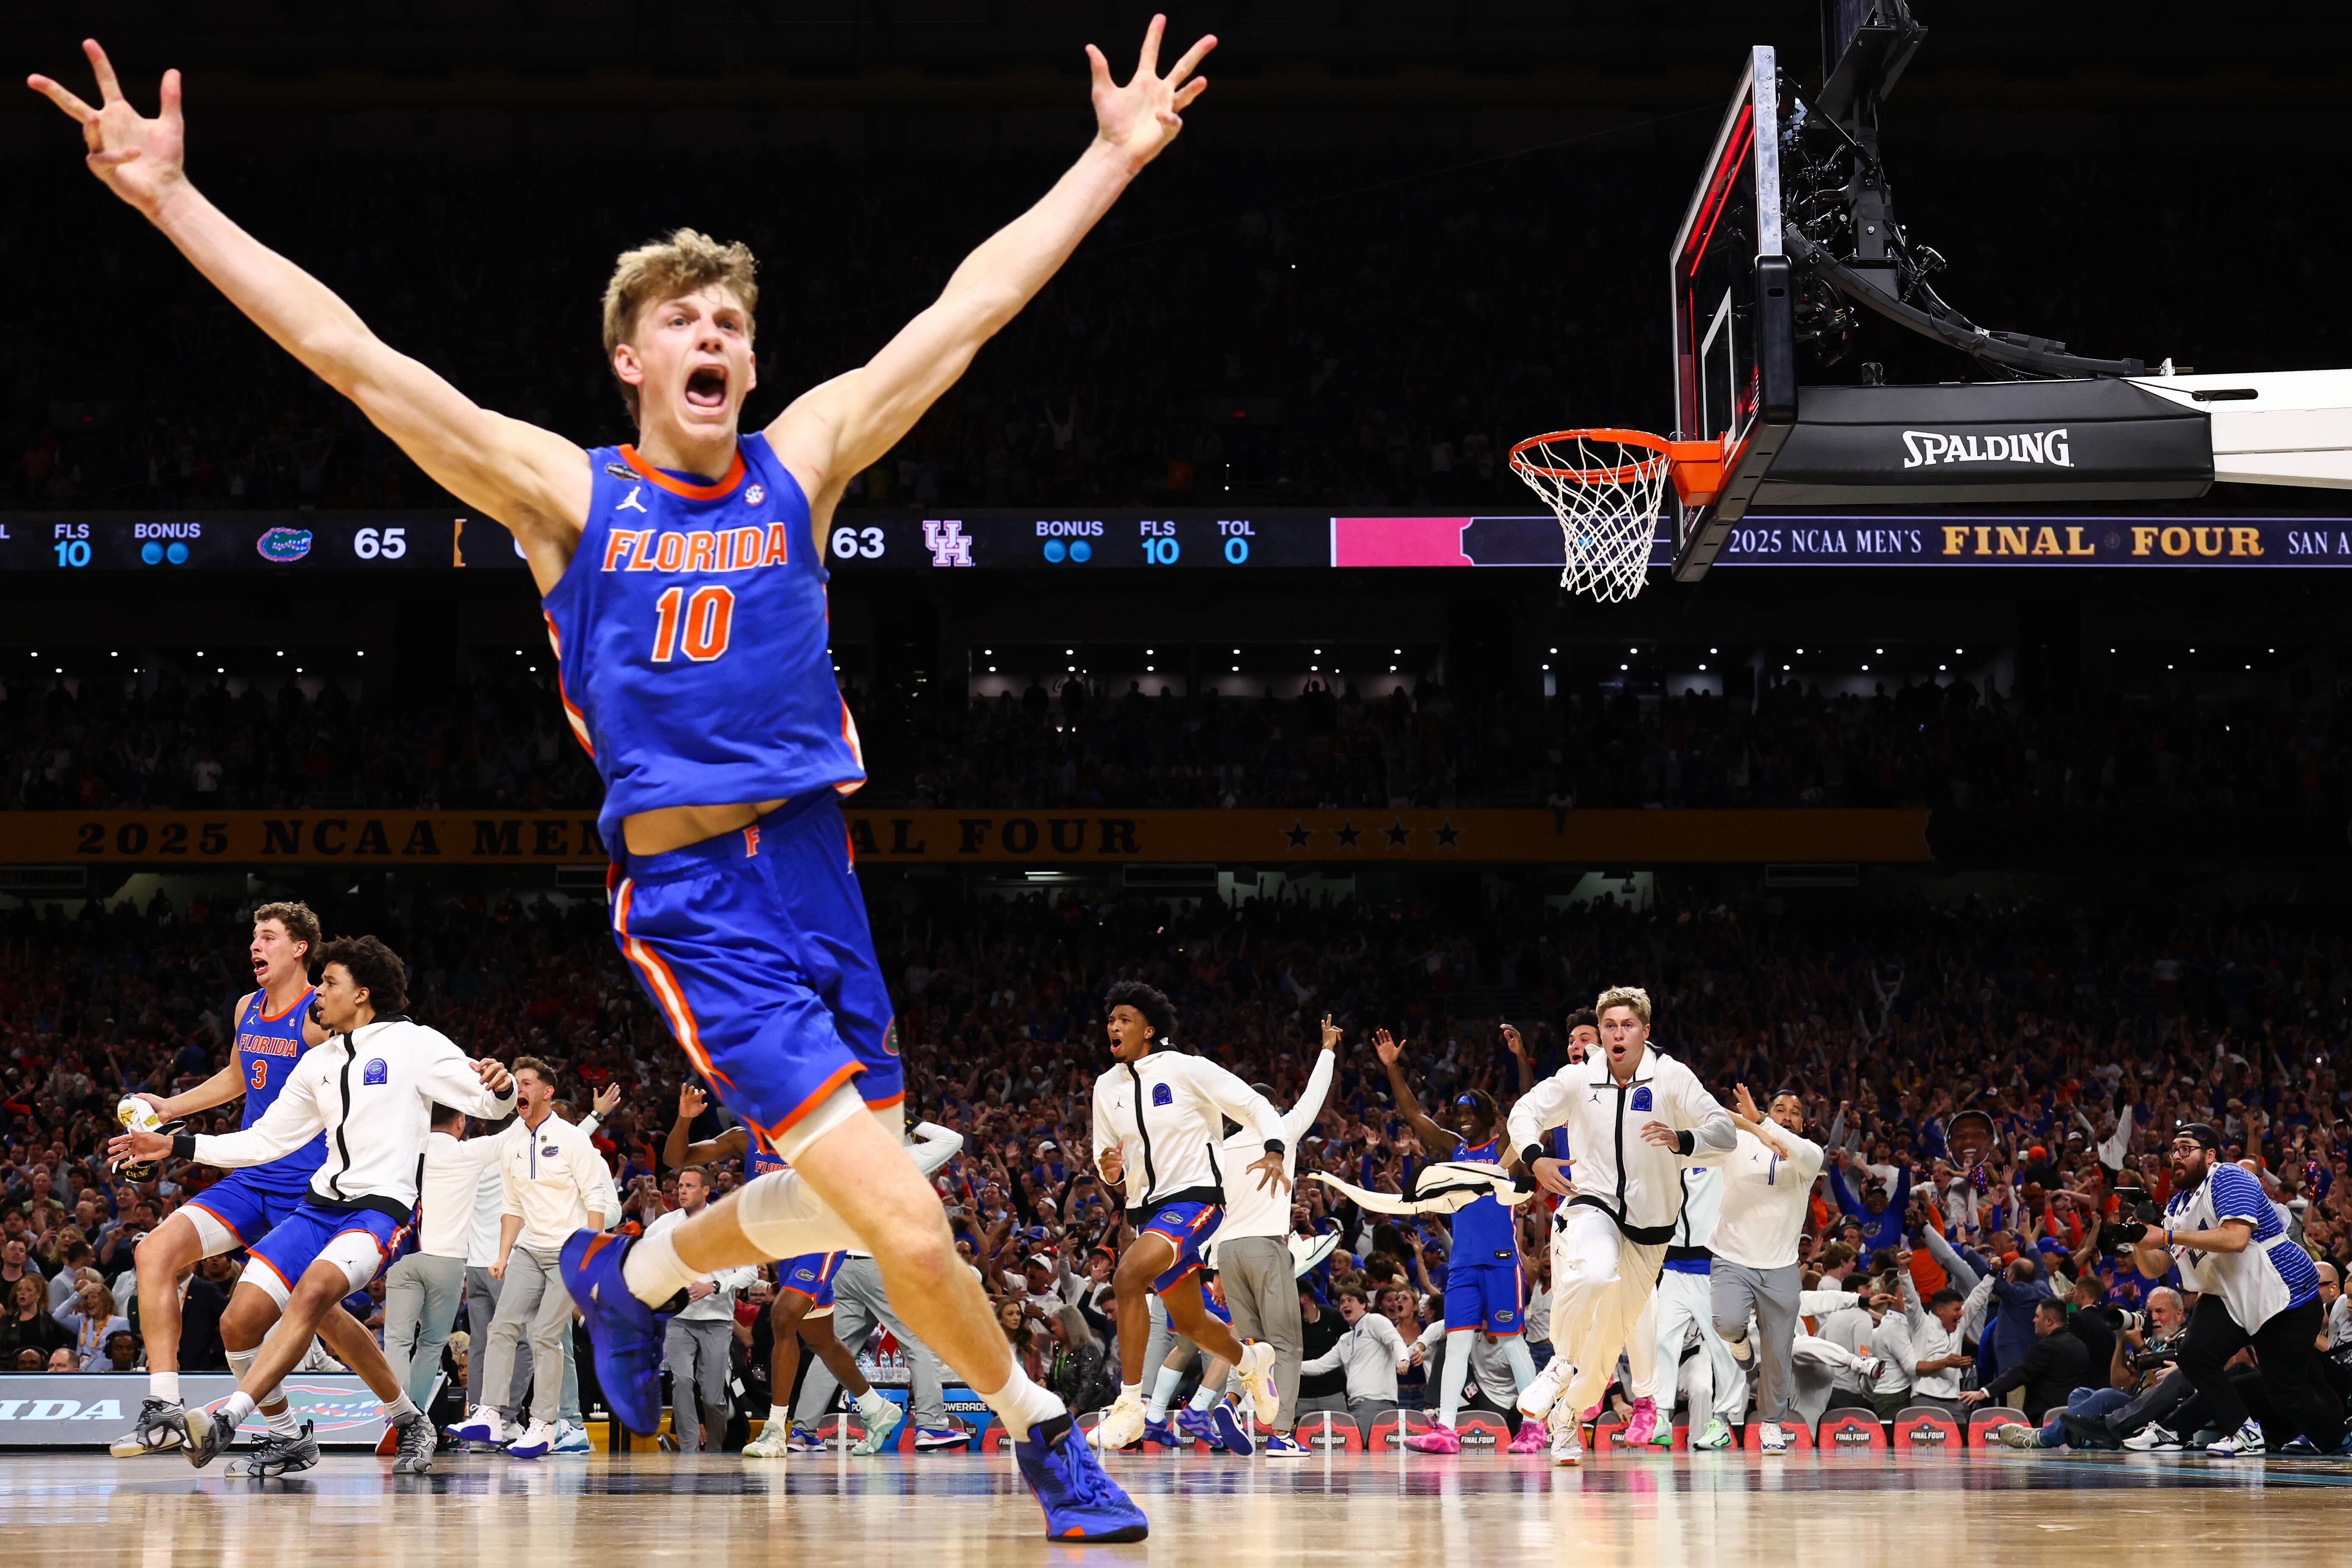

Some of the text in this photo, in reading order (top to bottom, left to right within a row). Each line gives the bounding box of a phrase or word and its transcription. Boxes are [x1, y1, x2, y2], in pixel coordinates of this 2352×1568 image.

[1903, 429, 2070, 468] SPALDING
[55, 523, 89, 539] FLS
[134, 523, 201, 538] BONUS
[1036, 521, 1104, 536] BONUS
[1140, 520, 1176, 536] FLS
[1217, 520, 1256, 536] TOL
[1729, 526, 2352, 556] 2025 NCAA MEN'S FINAL FOUR SAN A
[54, 540, 91, 567] 10
[354, 528, 406, 559] 65
[601, 522, 787, 572] FLORIDA
[832, 527, 885, 559] 63
[1141, 537, 1180, 564] 10
[1224, 536, 1249, 564] 0
[651, 585, 735, 663] 10
[76, 823, 228, 855] 2025
[261, 819, 441, 855] NCAA
[471, 820, 607, 855] MEN
[957, 818, 1141, 854] FOUR
[743, 825, 760, 858] F
[238, 1033, 298, 1057] FLORIDA
[251, 1059, 268, 1090] 3
[0, 1399, 125, 1420] IDA
[944, 1402, 987, 1411] OWERADE
[1910, 1431, 1945, 1439] FINAL FOUR
